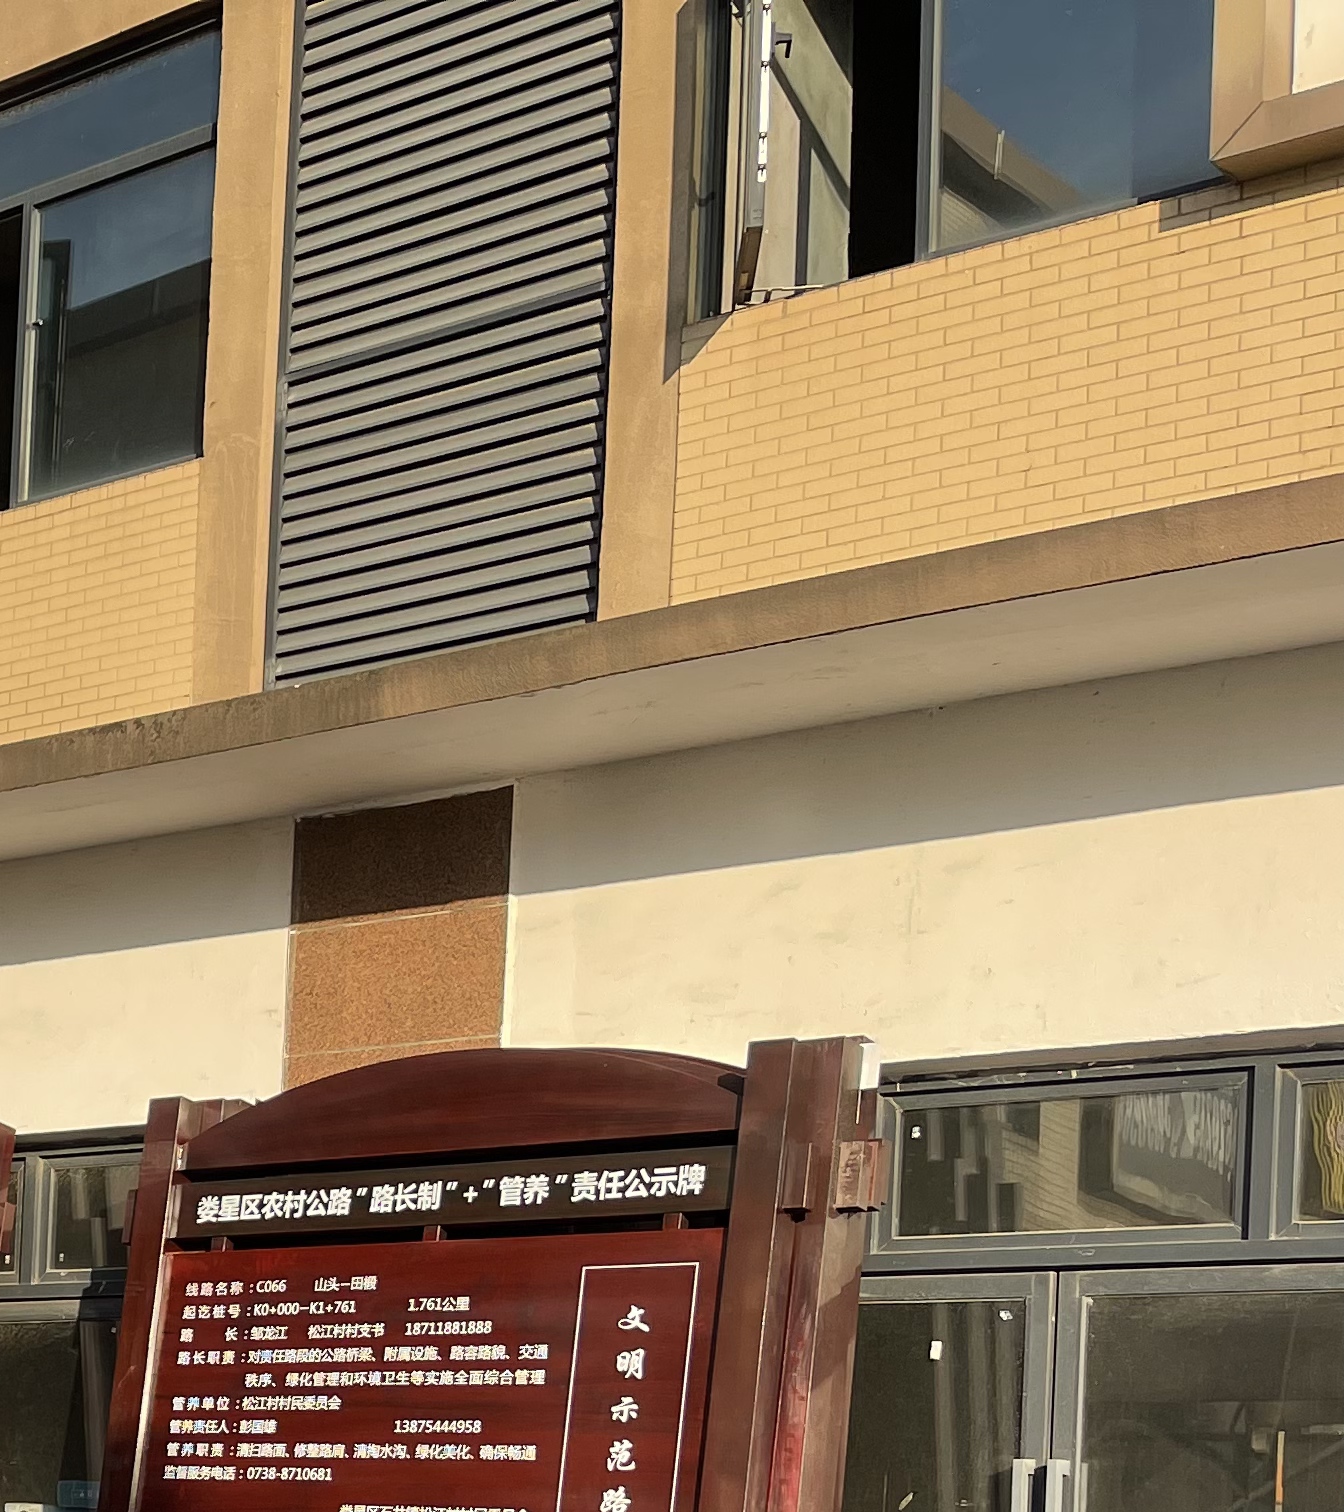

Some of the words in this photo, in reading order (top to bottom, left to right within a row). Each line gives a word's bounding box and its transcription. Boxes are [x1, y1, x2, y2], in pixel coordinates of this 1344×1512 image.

[407, 1296, 471, 1312] 1.761公里
[307, 1322, 385, 1340] 松江村村支书
[404, 1320, 493, 1336] 18711881888
[393, 1419, 482, 1434] 13875444958
